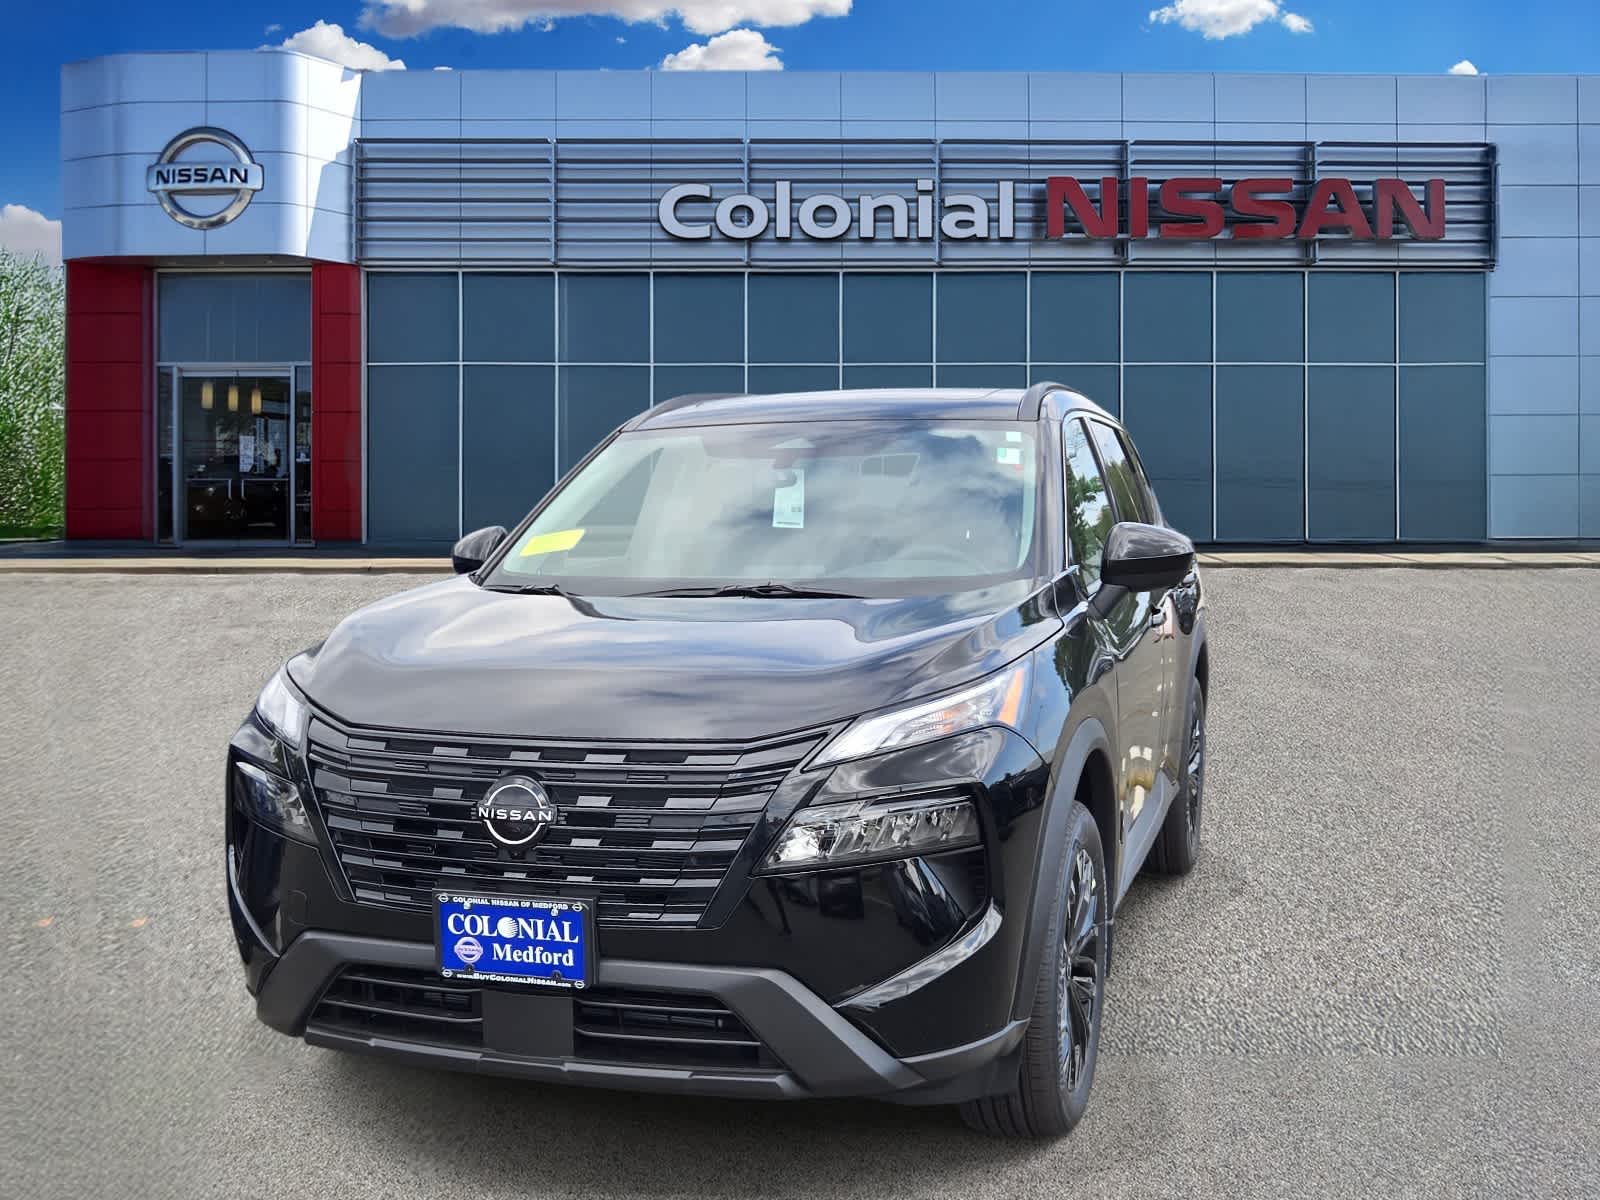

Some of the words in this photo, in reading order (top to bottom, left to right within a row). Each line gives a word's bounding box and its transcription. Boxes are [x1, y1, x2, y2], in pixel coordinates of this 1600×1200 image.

[156, 167, 248, 185] NISSAN
[658, 179, 1015, 239] Colonial
[1046, 176, 1446, 240] NISSAN
[478, 807, 552, 821] NISSAN
[452, 896, 490, 905] COLONIAL
[447, 913, 579, 943] COLONIAL
[492, 943, 574, 966] Medford
